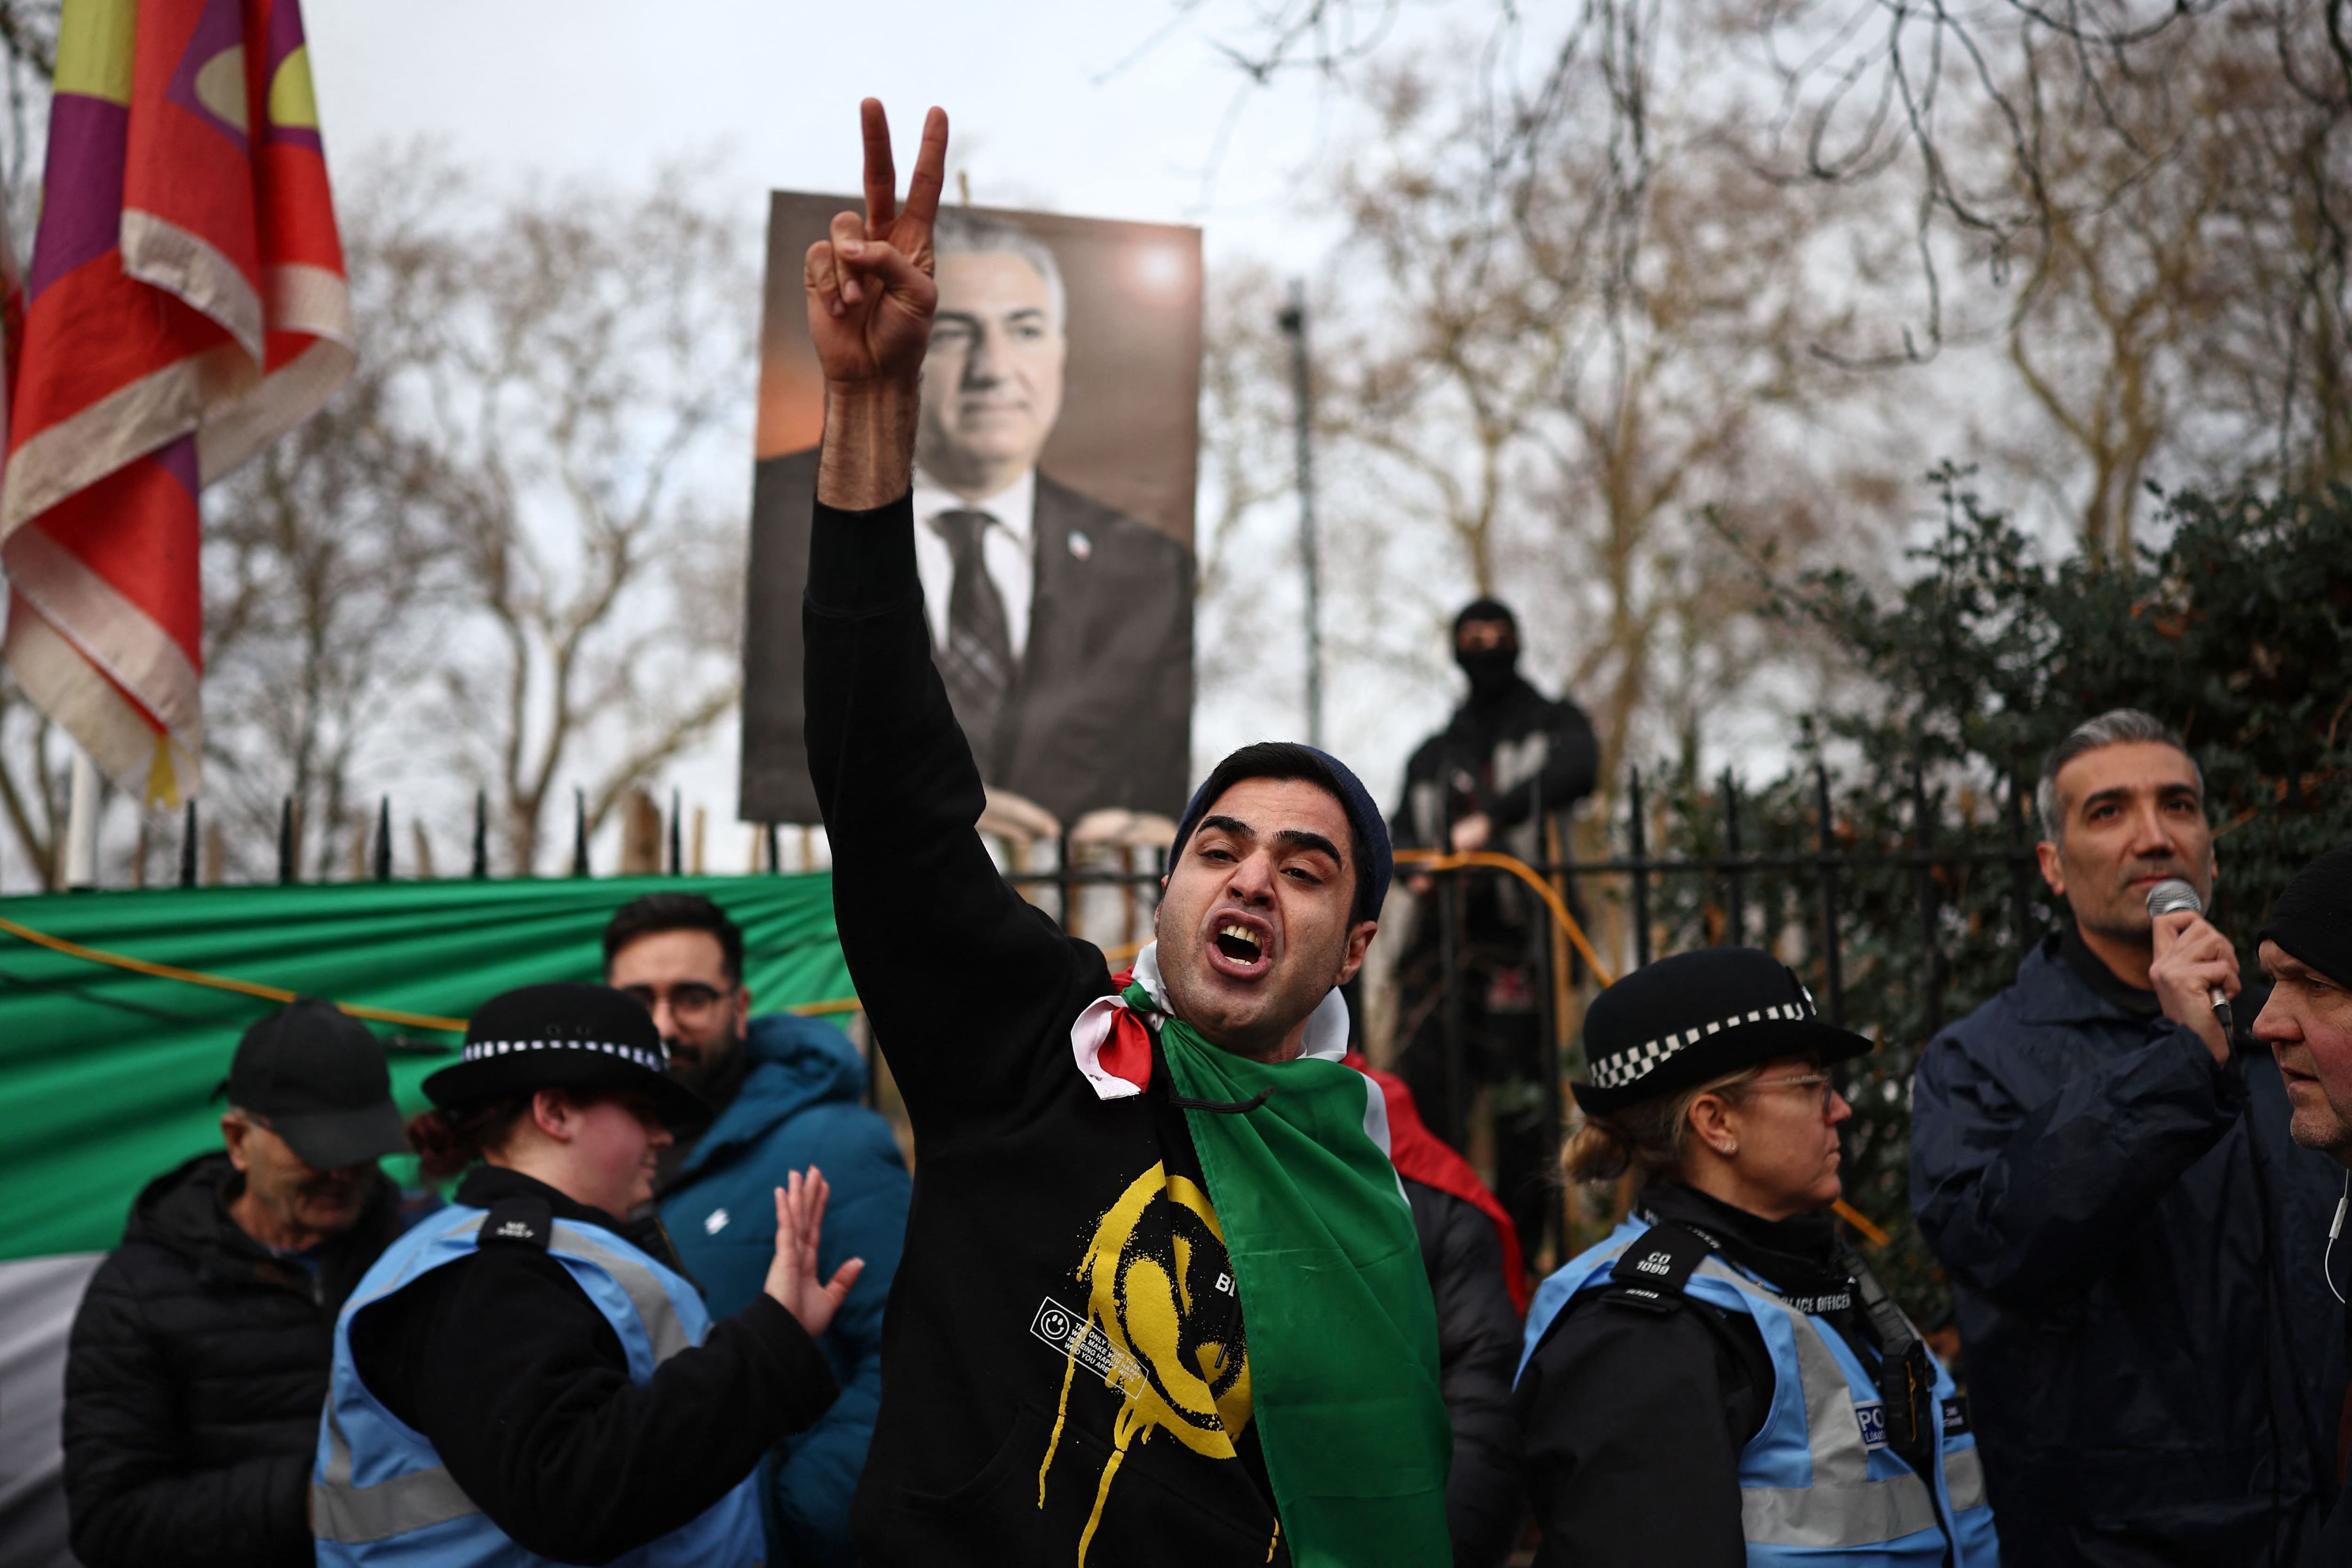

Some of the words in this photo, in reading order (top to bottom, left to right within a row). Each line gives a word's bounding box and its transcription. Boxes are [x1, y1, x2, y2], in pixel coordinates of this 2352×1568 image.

[1648, 1251, 1671, 1265] CO
[1781, 1297, 1815, 1313] LICE
[1065, 1342, 1081, 1354] WHO
[1081, 1352, 1096, 1364] YOU
[1095, 1362, 1110, 1373] ARE
[1072, 1329, 1086, 1343] WILL
[1088, 1339, 1107, 1354] MAKE
[1106, 1352, 1120, 1364] YOU
[1121, 1362, 1141, 1379] HAPPY
[1075, 1323, 1088, 1333] THE
[1089, 1331, 1106, 1345] ONLY
[1107, 1343, 1125, 1359] THING
[1126, 1357, 1141, 1370] THAT
[1076, 1341, 1096, 1355] BEING
[1096, 1353, 1118, 1370] HAPPY
[1119, 1369, 1135, 1382] WITH
